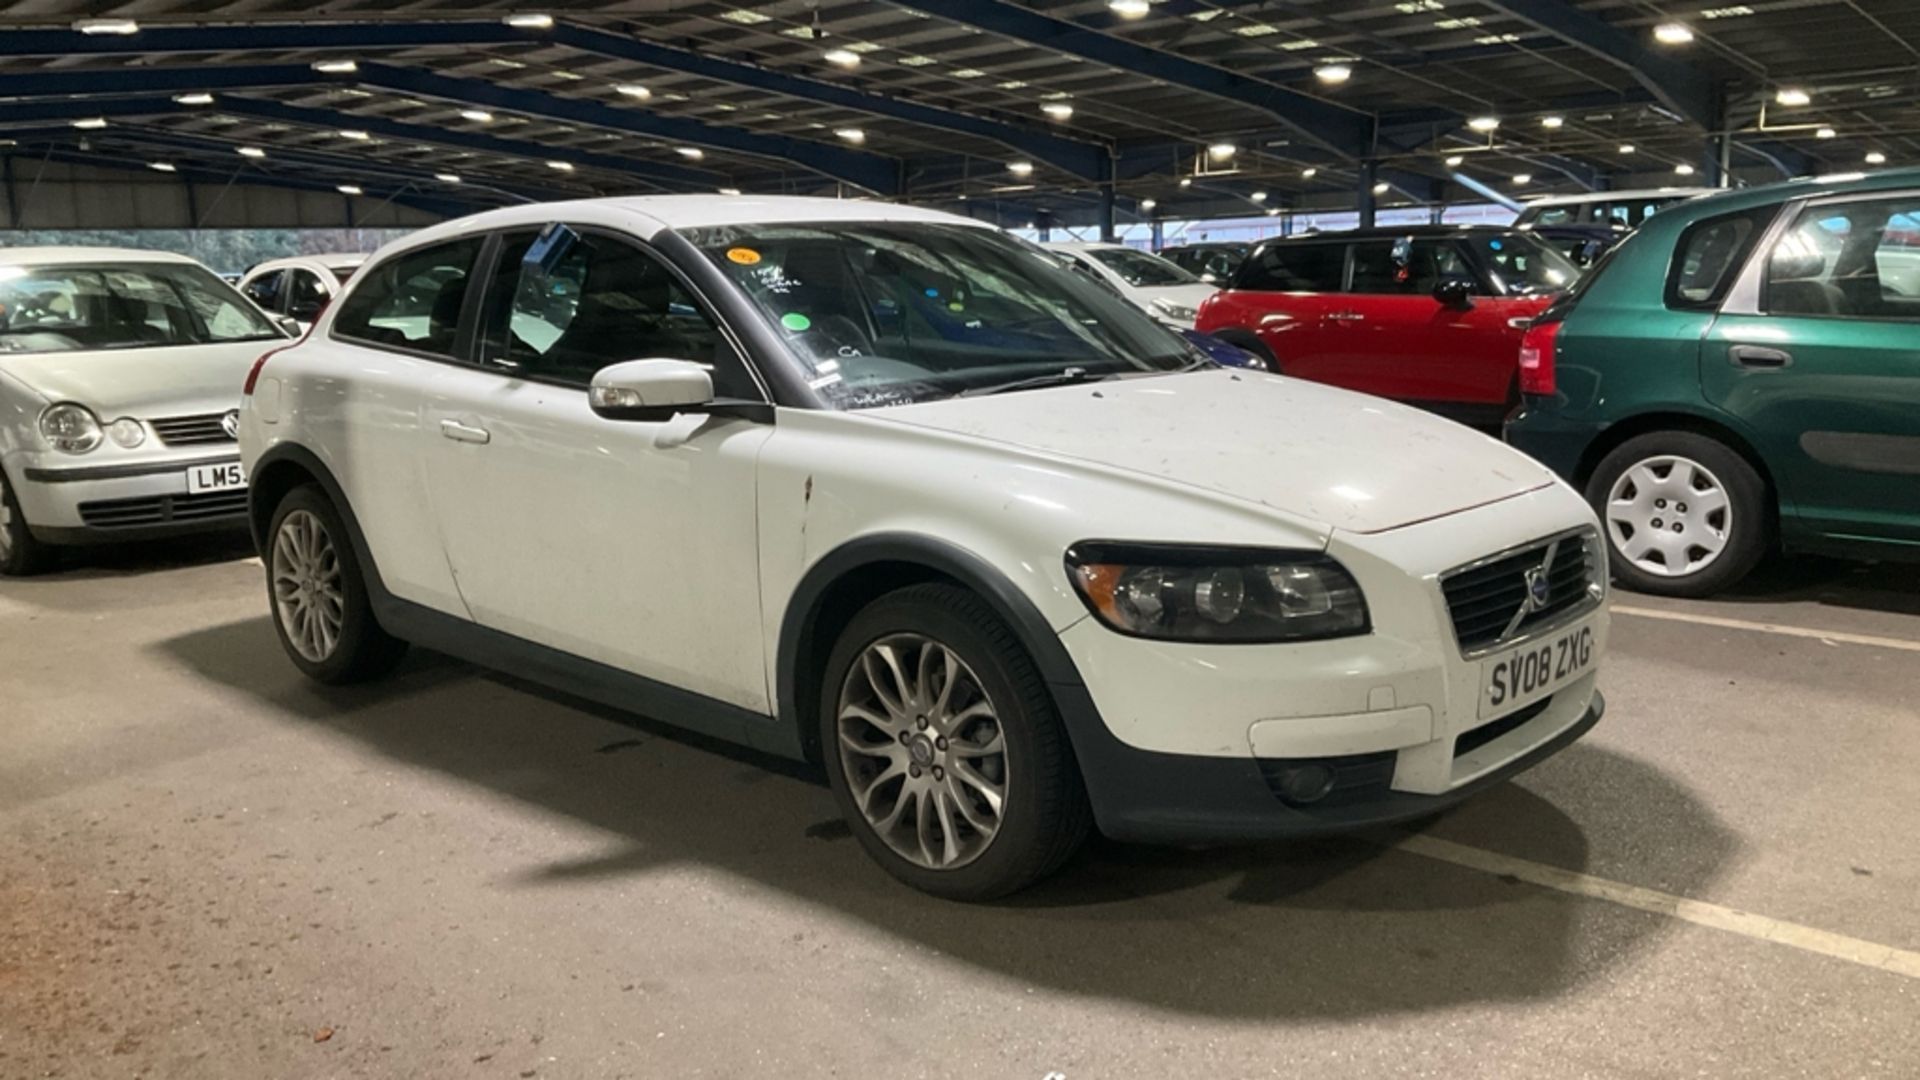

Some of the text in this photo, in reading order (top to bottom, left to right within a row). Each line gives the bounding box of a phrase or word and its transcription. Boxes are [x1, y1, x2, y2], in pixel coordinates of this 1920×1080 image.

[198, 465, 248, 489] LM5
[1491, 626, 1591, 705] SV08 ZXG
